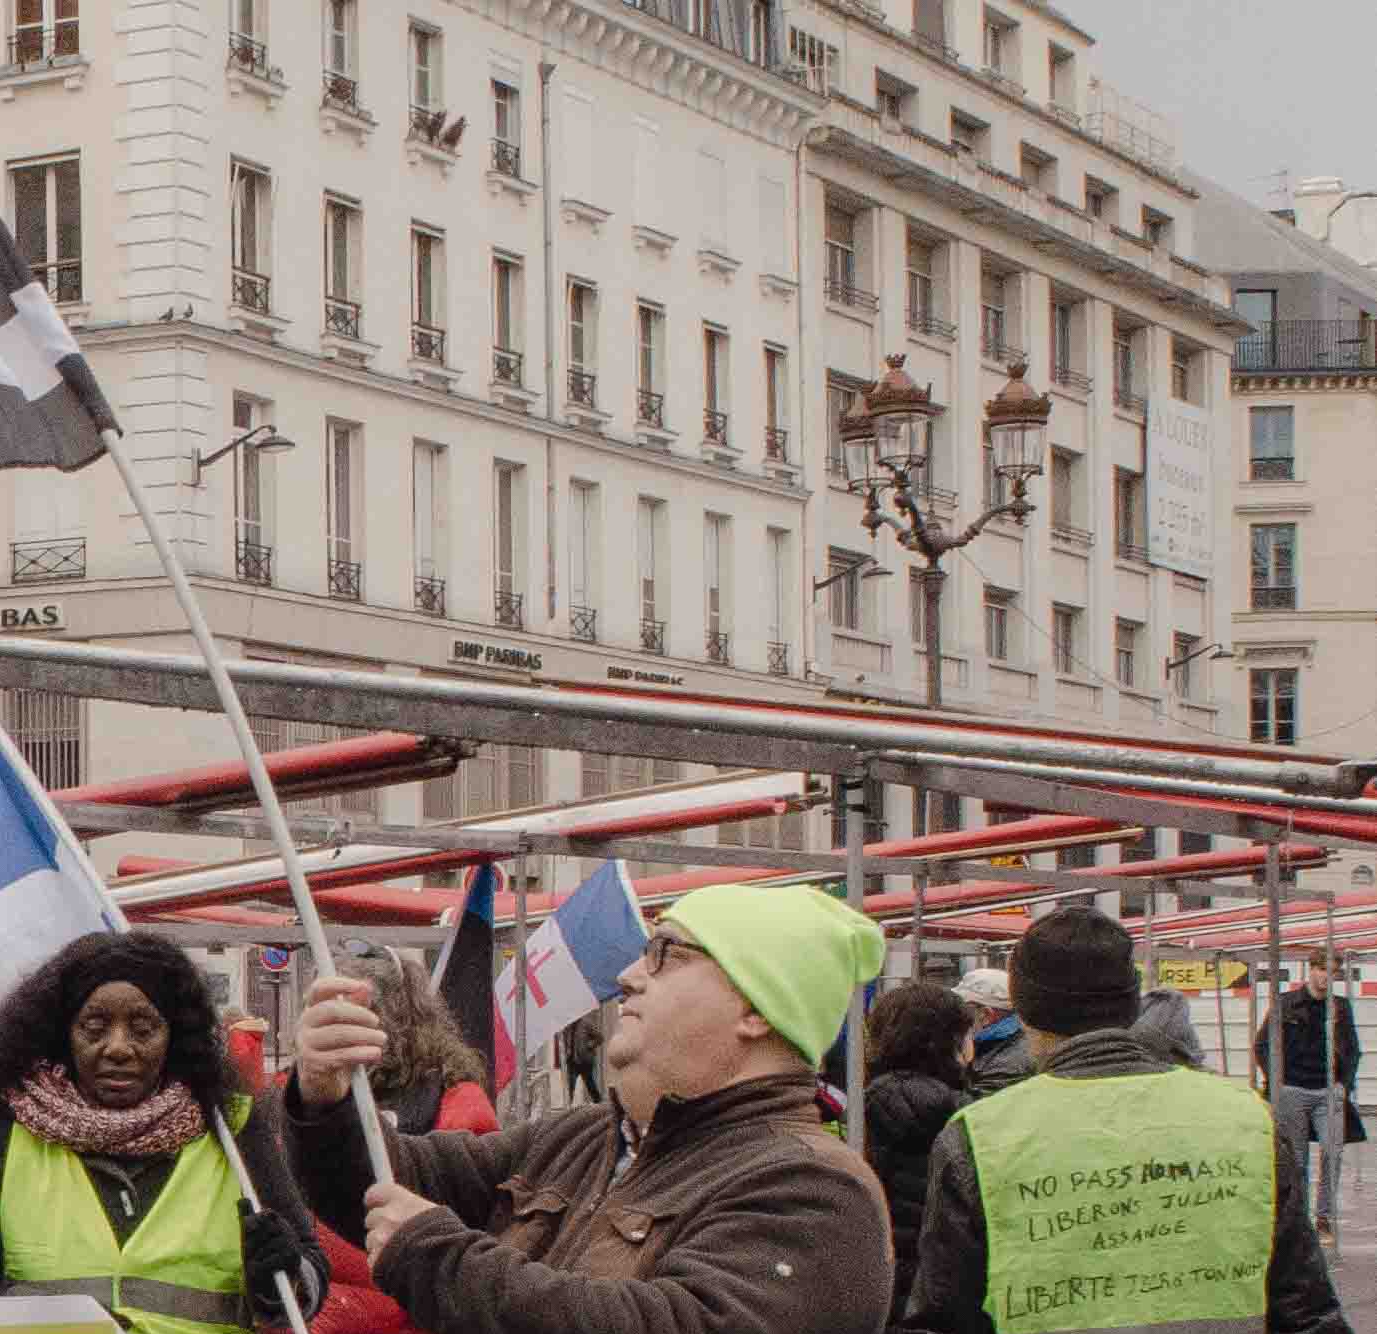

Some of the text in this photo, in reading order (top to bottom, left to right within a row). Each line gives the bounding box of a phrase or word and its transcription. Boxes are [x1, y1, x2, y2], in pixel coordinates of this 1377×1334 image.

[454, 640, 543, 671] BNP PARIBAS
[1018, 1175, 1057, 1201] NO
[1071, 1165, 1133, 1192] PASS
[1092, 1220, 1188, 1250] ASSANGE
